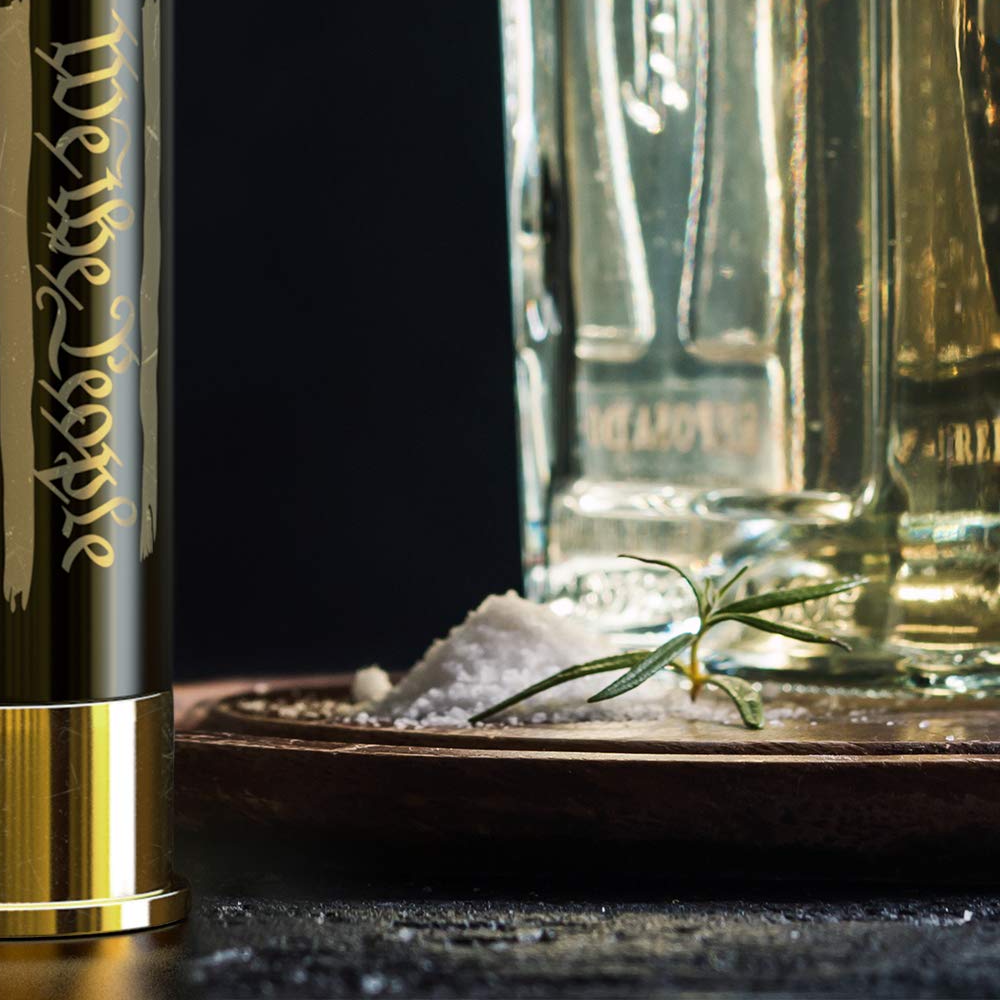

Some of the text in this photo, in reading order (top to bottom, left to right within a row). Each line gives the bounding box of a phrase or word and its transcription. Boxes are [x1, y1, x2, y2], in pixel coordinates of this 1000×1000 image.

[34, 9, 139, 573] We the People
